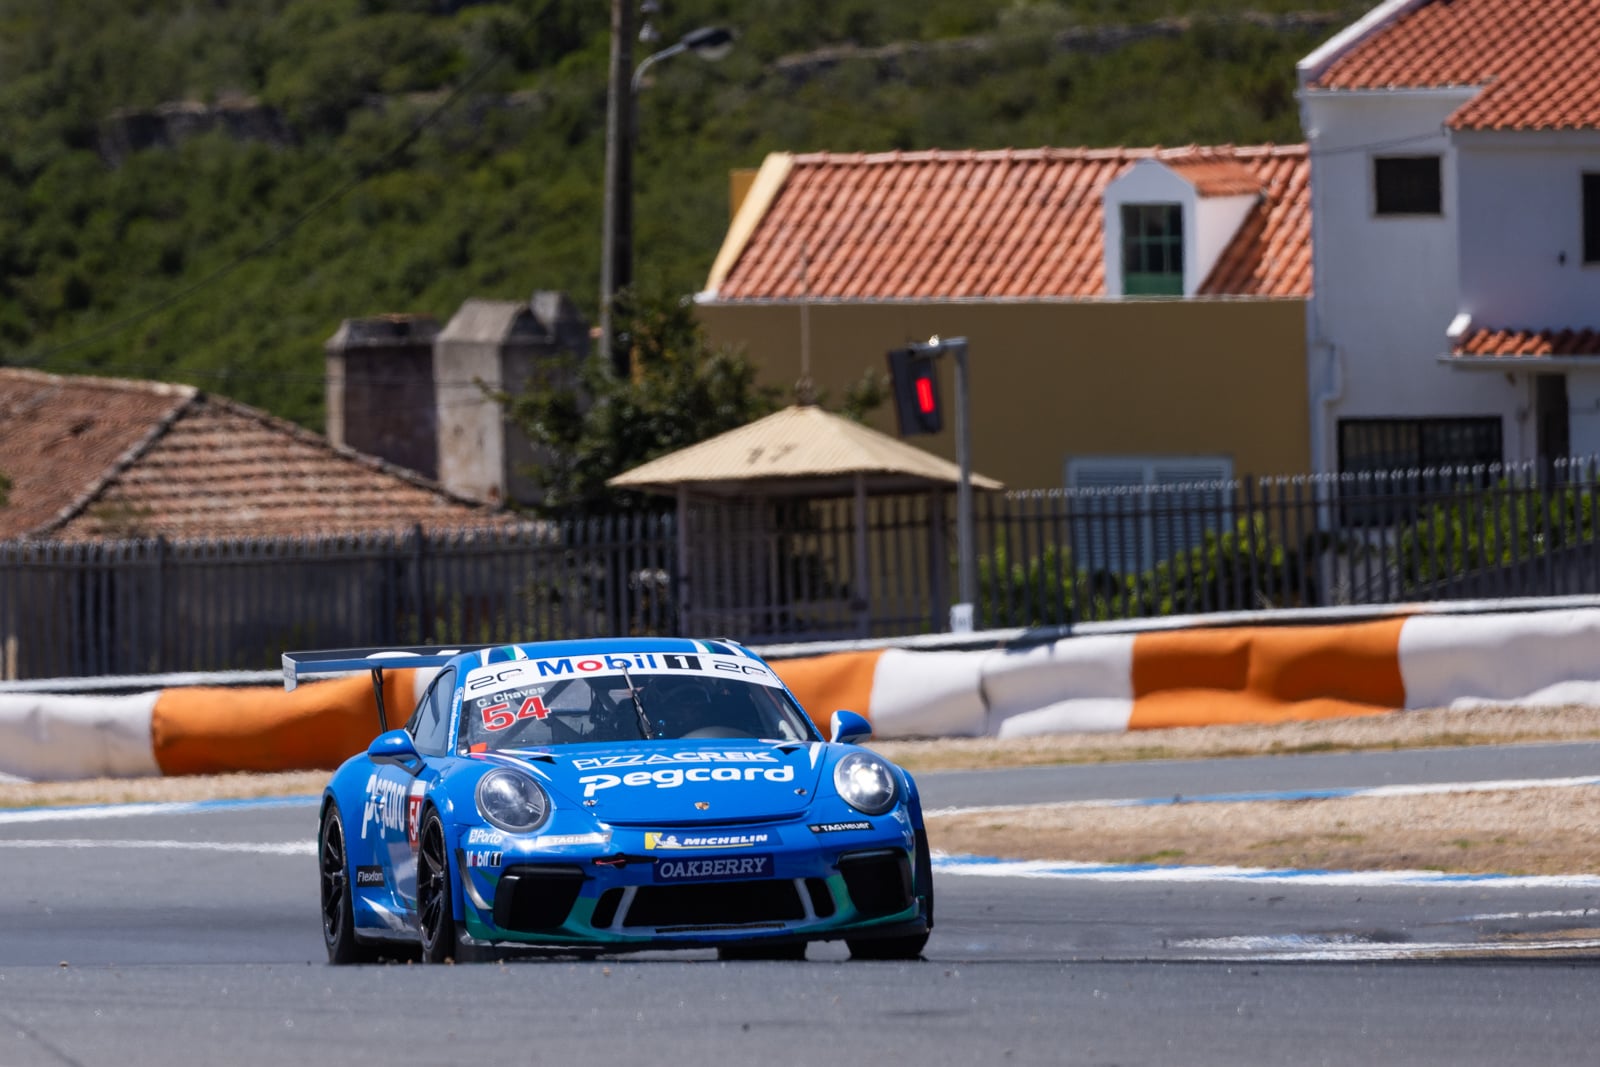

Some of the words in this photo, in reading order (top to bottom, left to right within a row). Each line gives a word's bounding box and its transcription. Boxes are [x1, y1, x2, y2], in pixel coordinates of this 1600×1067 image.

[536, 654, 658, 677] Mobil
[476, 698, 492, 708] C.
[493, 687, 546, 703] Chaves
[481, 695, 552, 732] 54
[683, 834, 768, 846] MICHELIN
[660, 858, 767, 878] OAKBERRY
